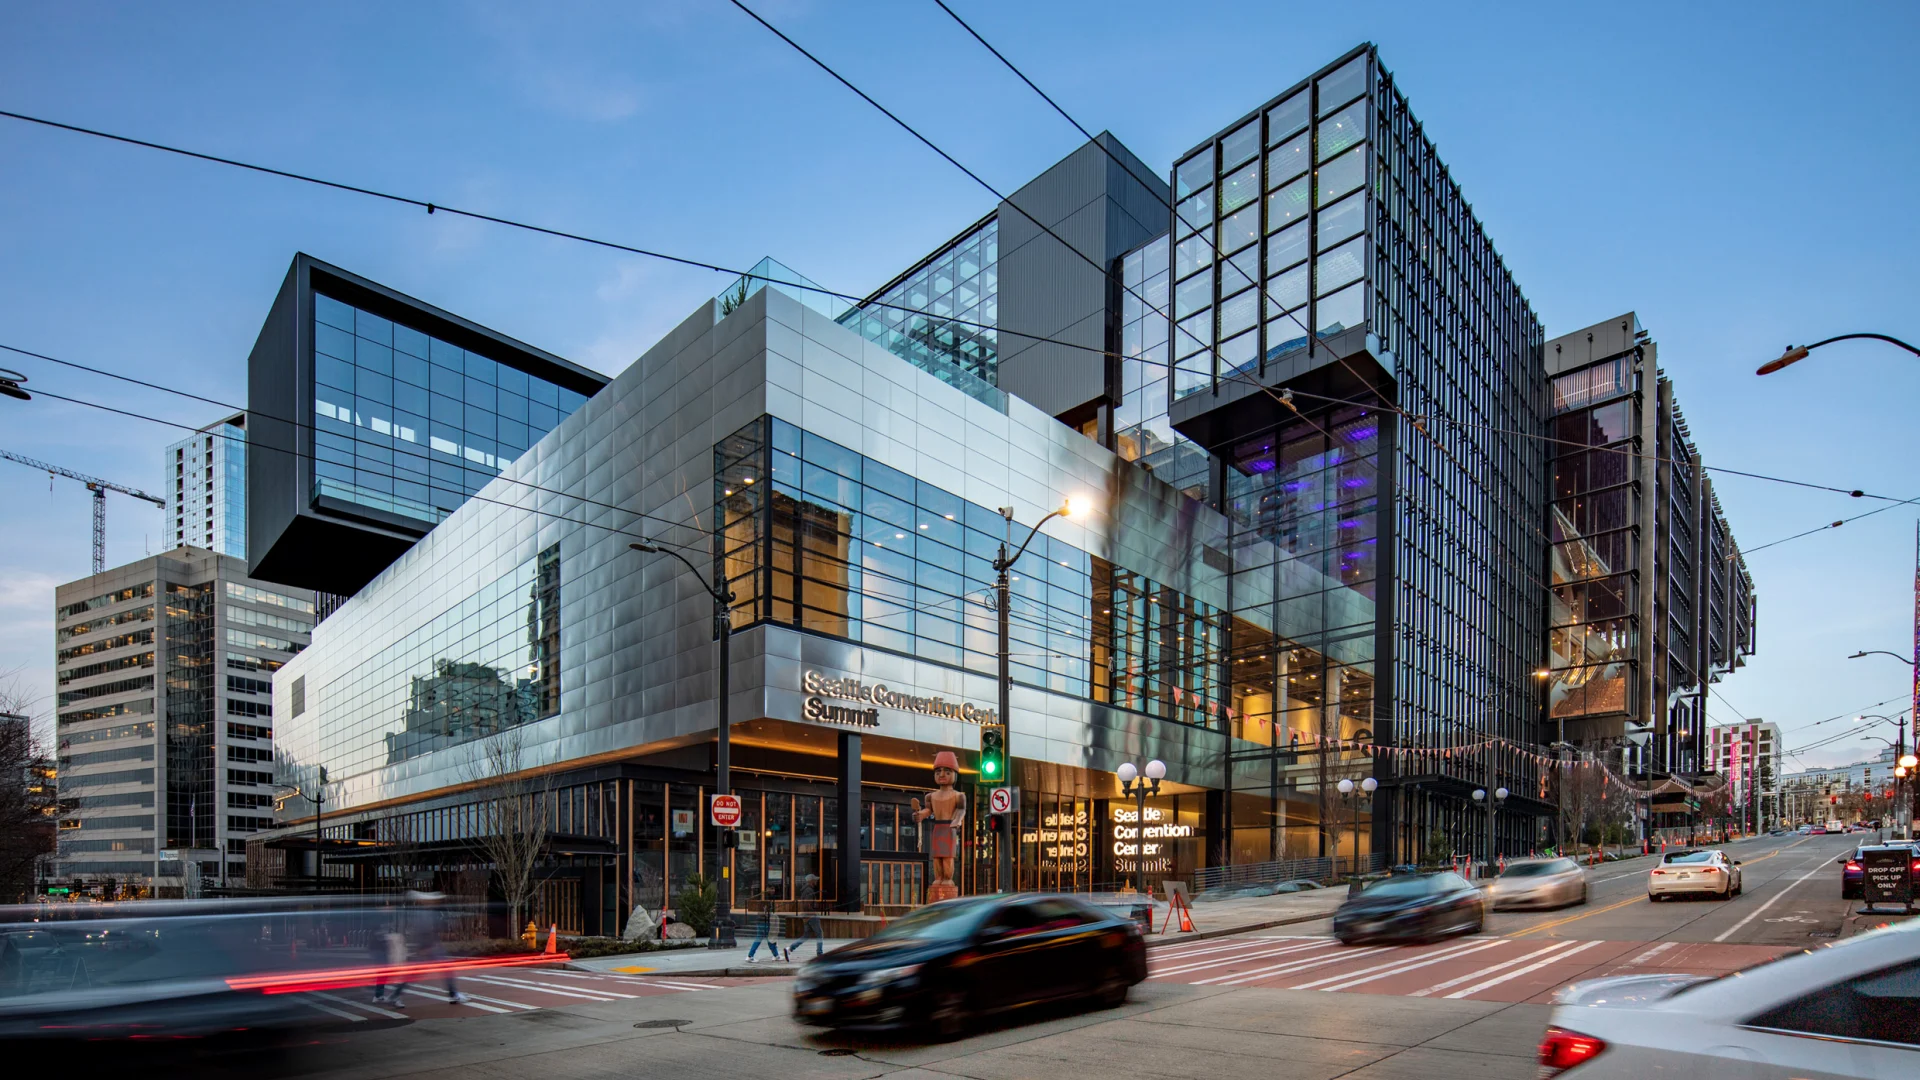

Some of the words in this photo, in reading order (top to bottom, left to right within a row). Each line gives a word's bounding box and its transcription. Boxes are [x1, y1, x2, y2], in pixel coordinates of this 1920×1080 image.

[805, 670, 872, 702] Seattle
[871, 684, 961, 719] Convention
[961, 702, 999, 726] Cent
[805, 697, 880, 727] Summit
[1114, 807, 1161, 822] Seatle
